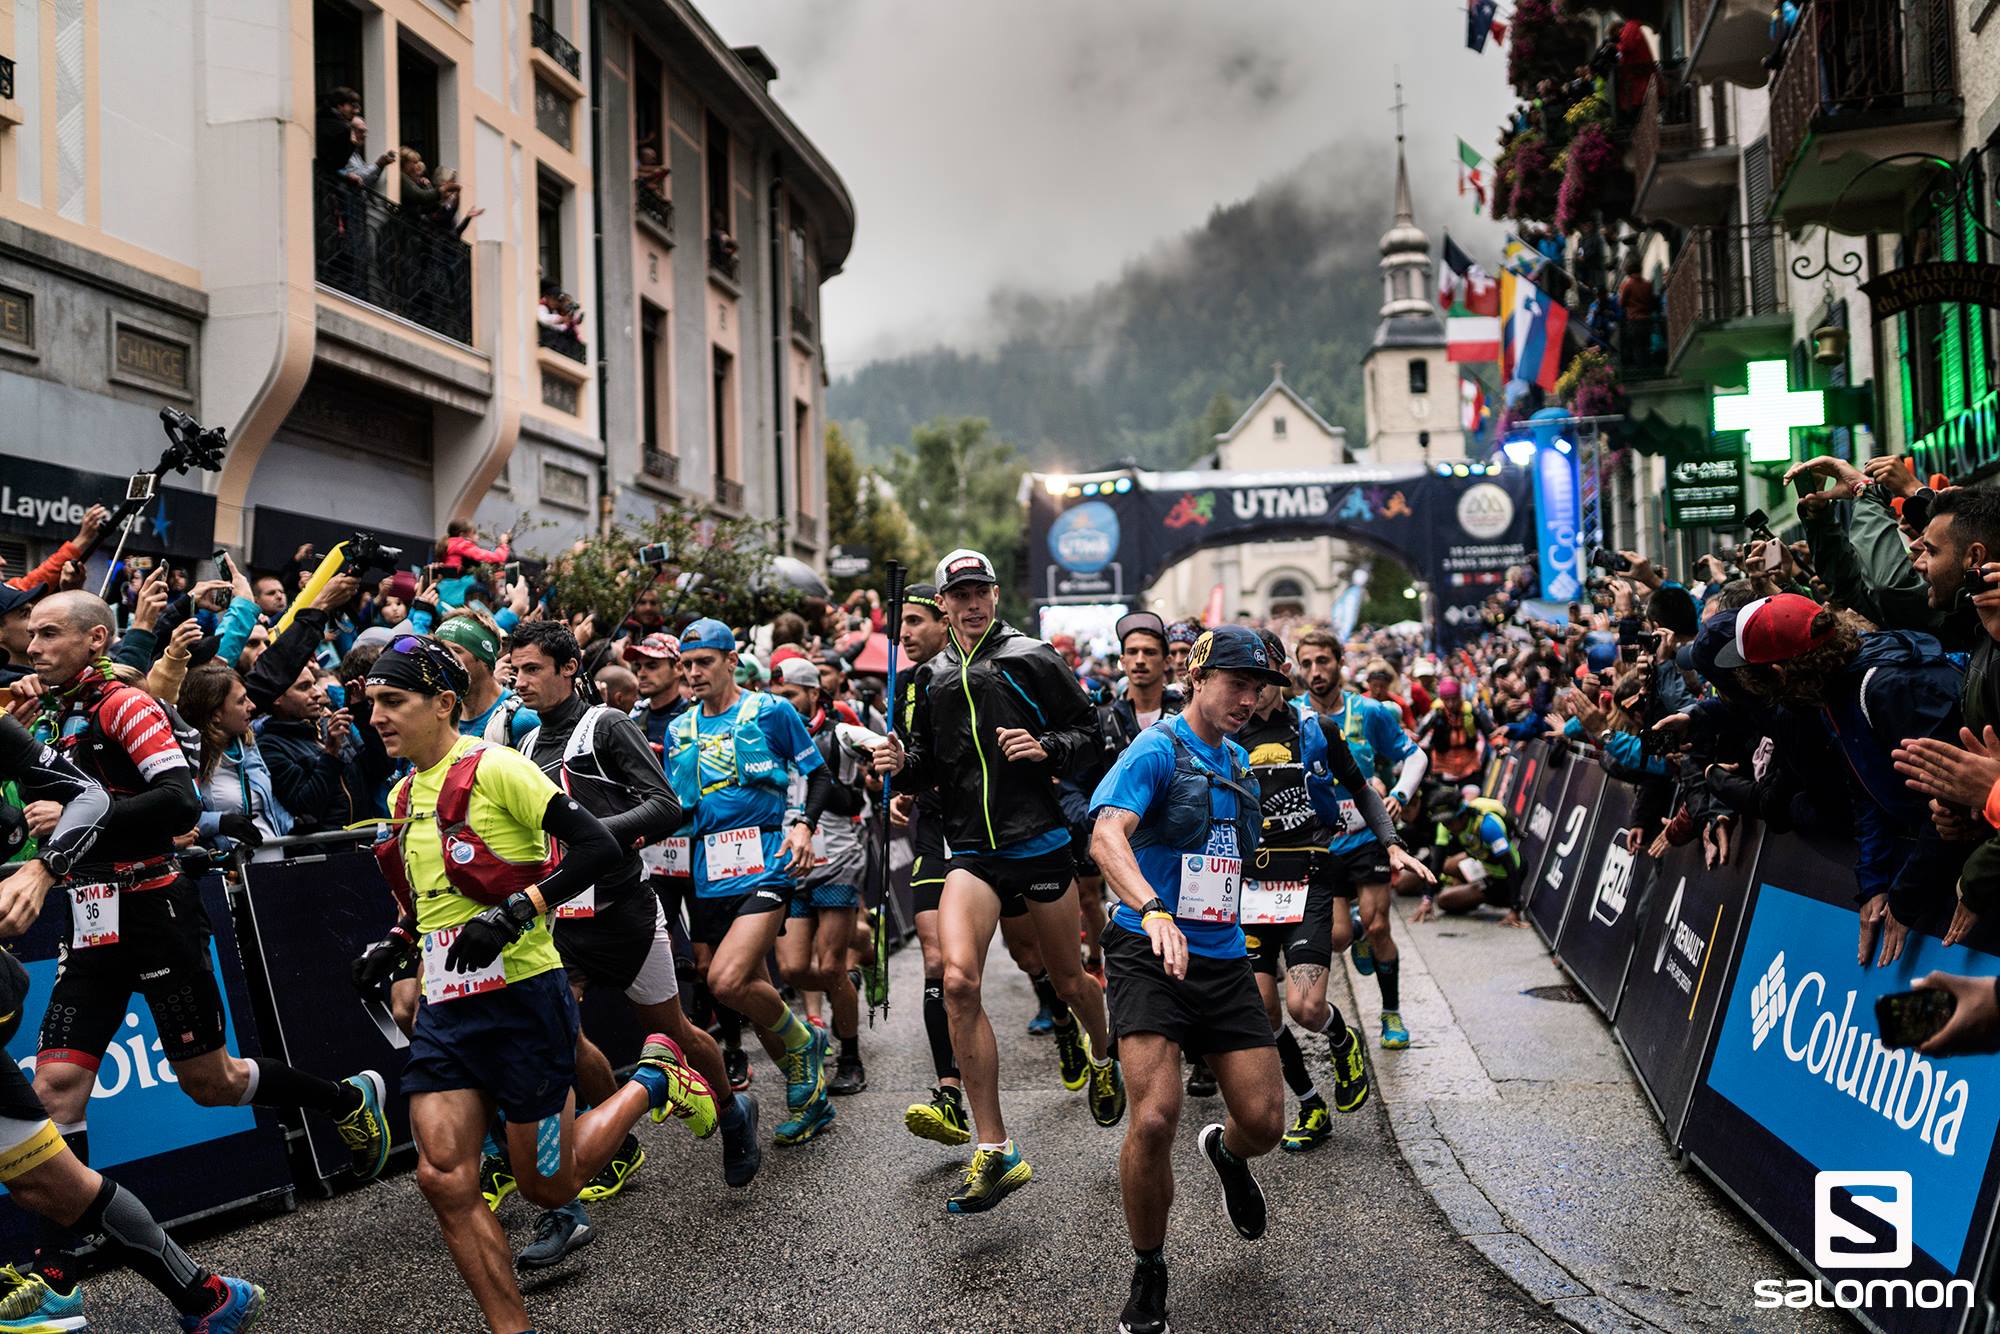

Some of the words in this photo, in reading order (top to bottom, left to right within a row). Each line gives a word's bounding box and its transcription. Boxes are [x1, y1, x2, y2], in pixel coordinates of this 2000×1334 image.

[117, 336, 182, 377] CHANGE
[1232, 486, 1329, 519] UTMB
[719, 828, 758, 844] UTMB
[662, 849, 678, 860] 40
[734, 843, 743, 856] 7
[1224, 876, 1233, 895] 6
[1274, 893, 1292, 905] 34
[85, 902, 100, 920] 36
[1673, 920, 1706, 968] RENAULT
[1783, 971, 1970, 1156] Columbia
